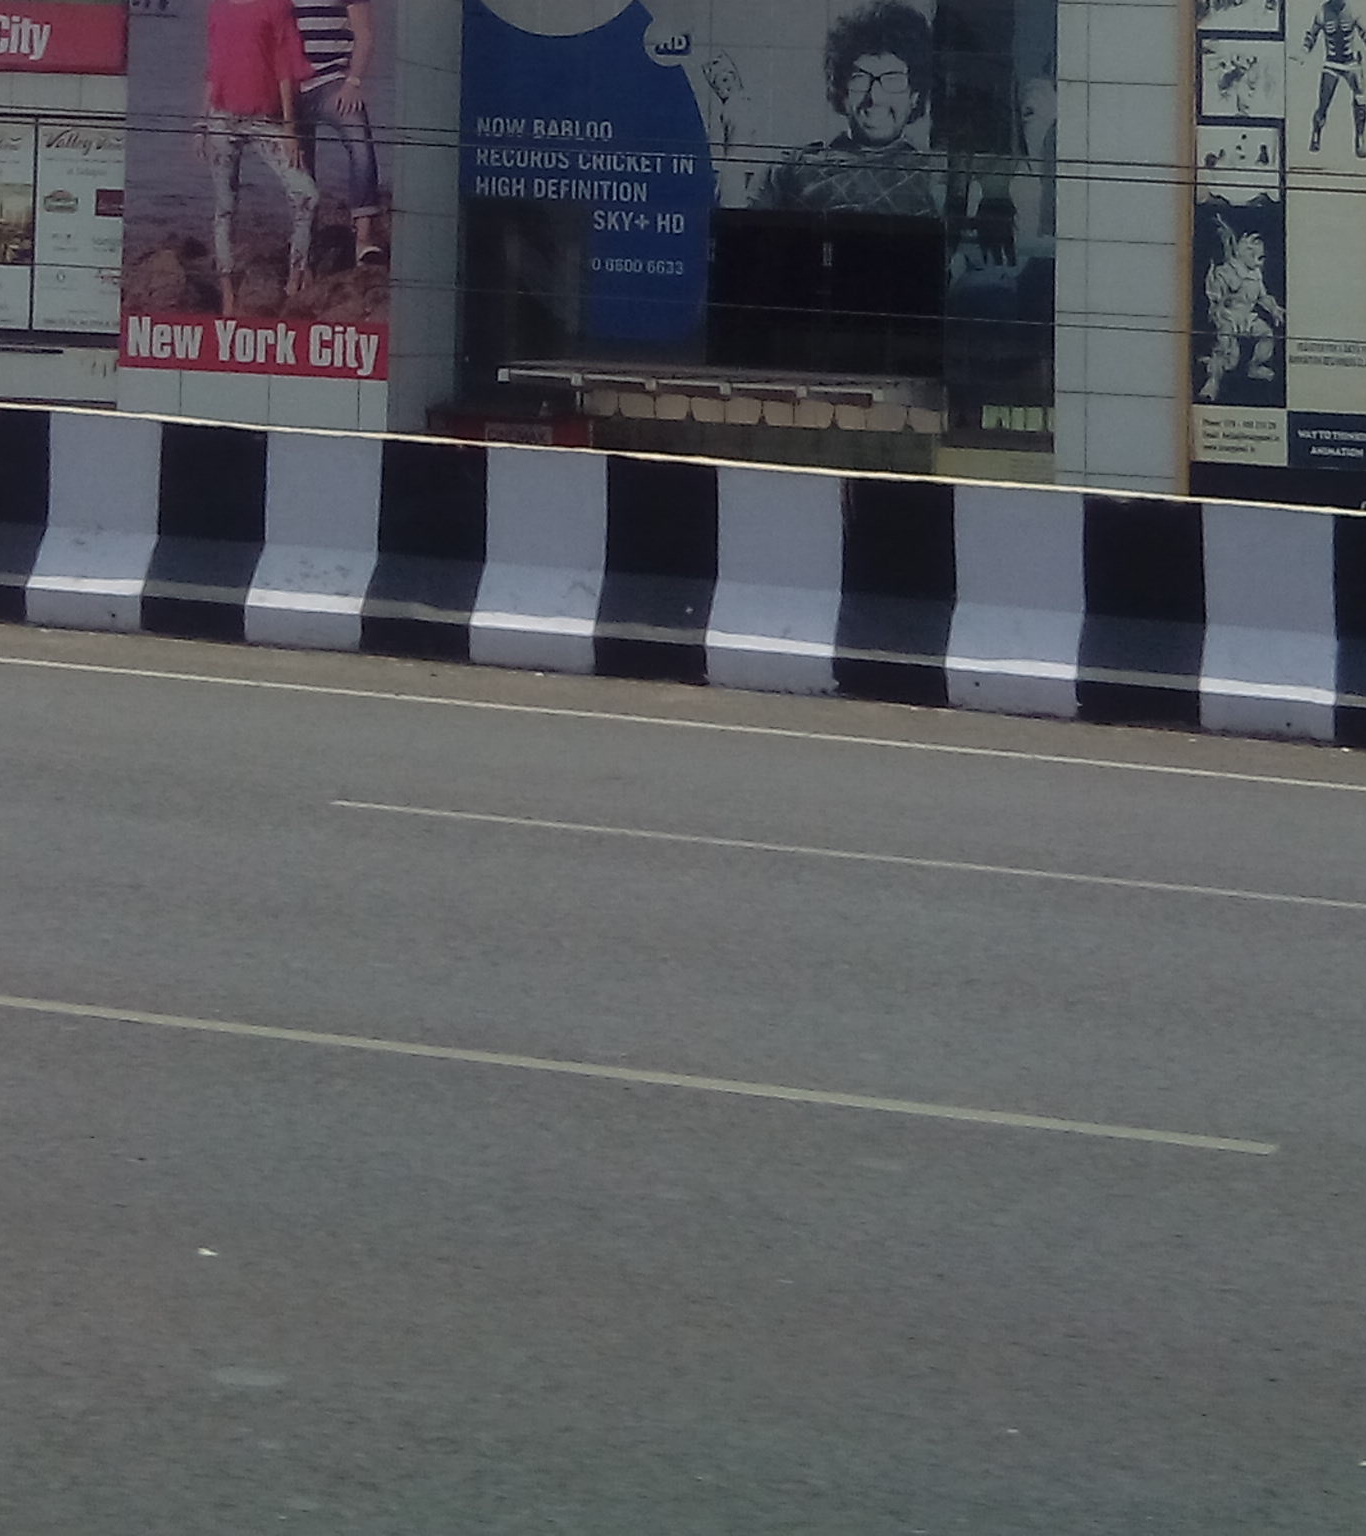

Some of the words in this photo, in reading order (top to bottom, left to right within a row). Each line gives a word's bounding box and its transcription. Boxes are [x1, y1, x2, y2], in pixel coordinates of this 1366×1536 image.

[476, 116, 526, 138] NOW
[476, 147, 569, 170] RECORDS
[578, 151, 665, 174] CRICKET
[672, 154, 694, 175] IN
[475, 175, 525, 198] HIGH
[534, 178, 648, 203] DEFINITION
[593, 210, 650, 232] SKY+
[656, 213, 685, 235] HD
[127, 315, 203, 361] New
[214, 319, 297, 365] York
[308, 324, 380, 376] City
